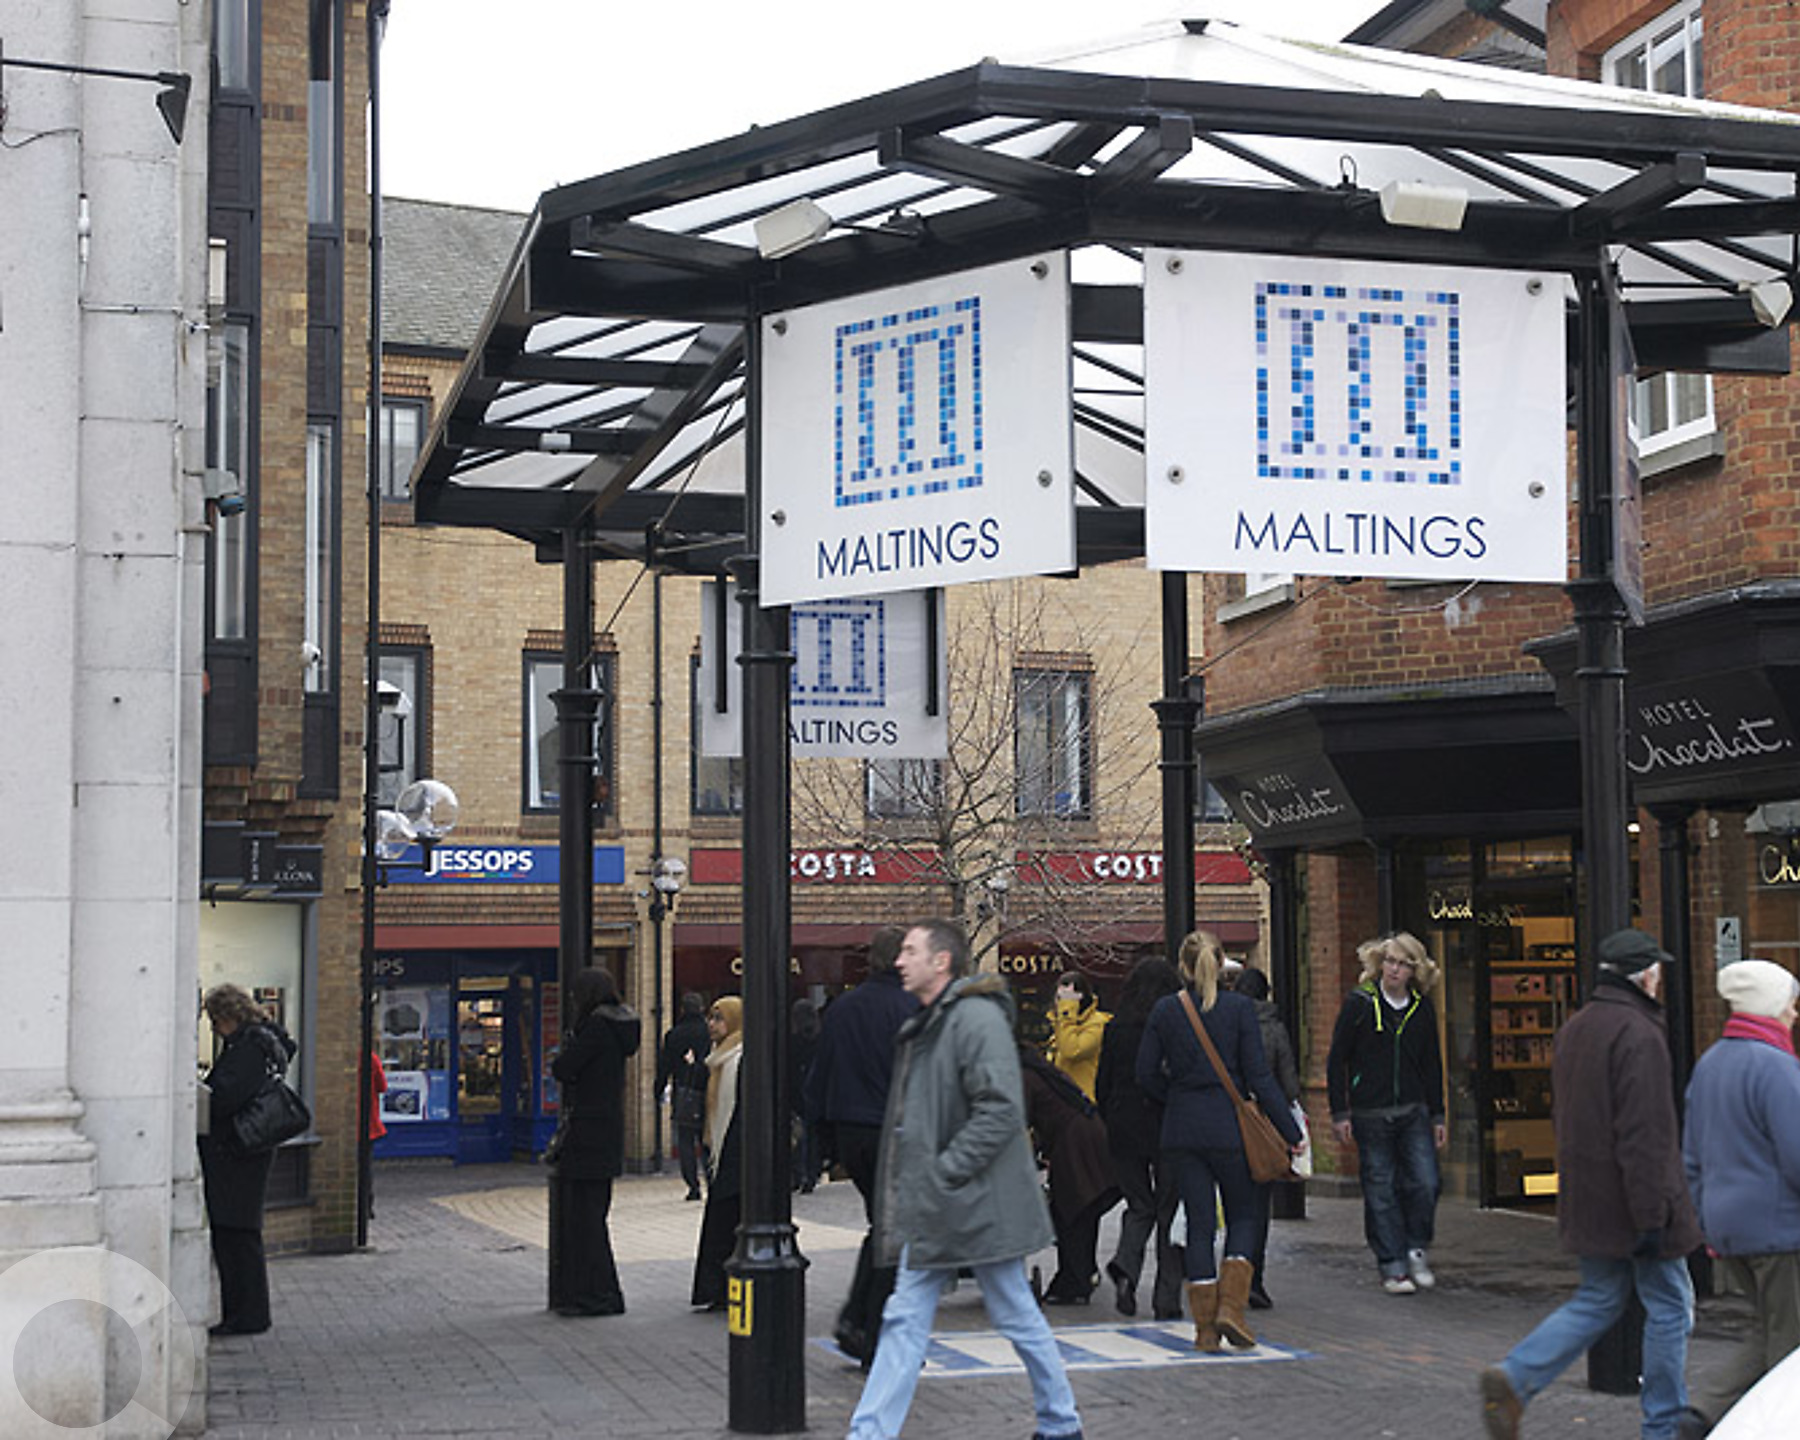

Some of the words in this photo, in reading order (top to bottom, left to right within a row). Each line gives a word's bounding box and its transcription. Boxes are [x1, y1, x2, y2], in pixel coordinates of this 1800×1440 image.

[817, 517, 1001, 581] MALTINGS
[1233, 511, 1488, 560] MALTINGS
[1638, 698, 1713, 728] HOTEL
[789, 719, 899, 746] ALTINGS
[424, 850, 534, 877] JESSOPS
[1094, 854, 1164, 880] COST
[1000, 954, 1064, 974] COSTA
